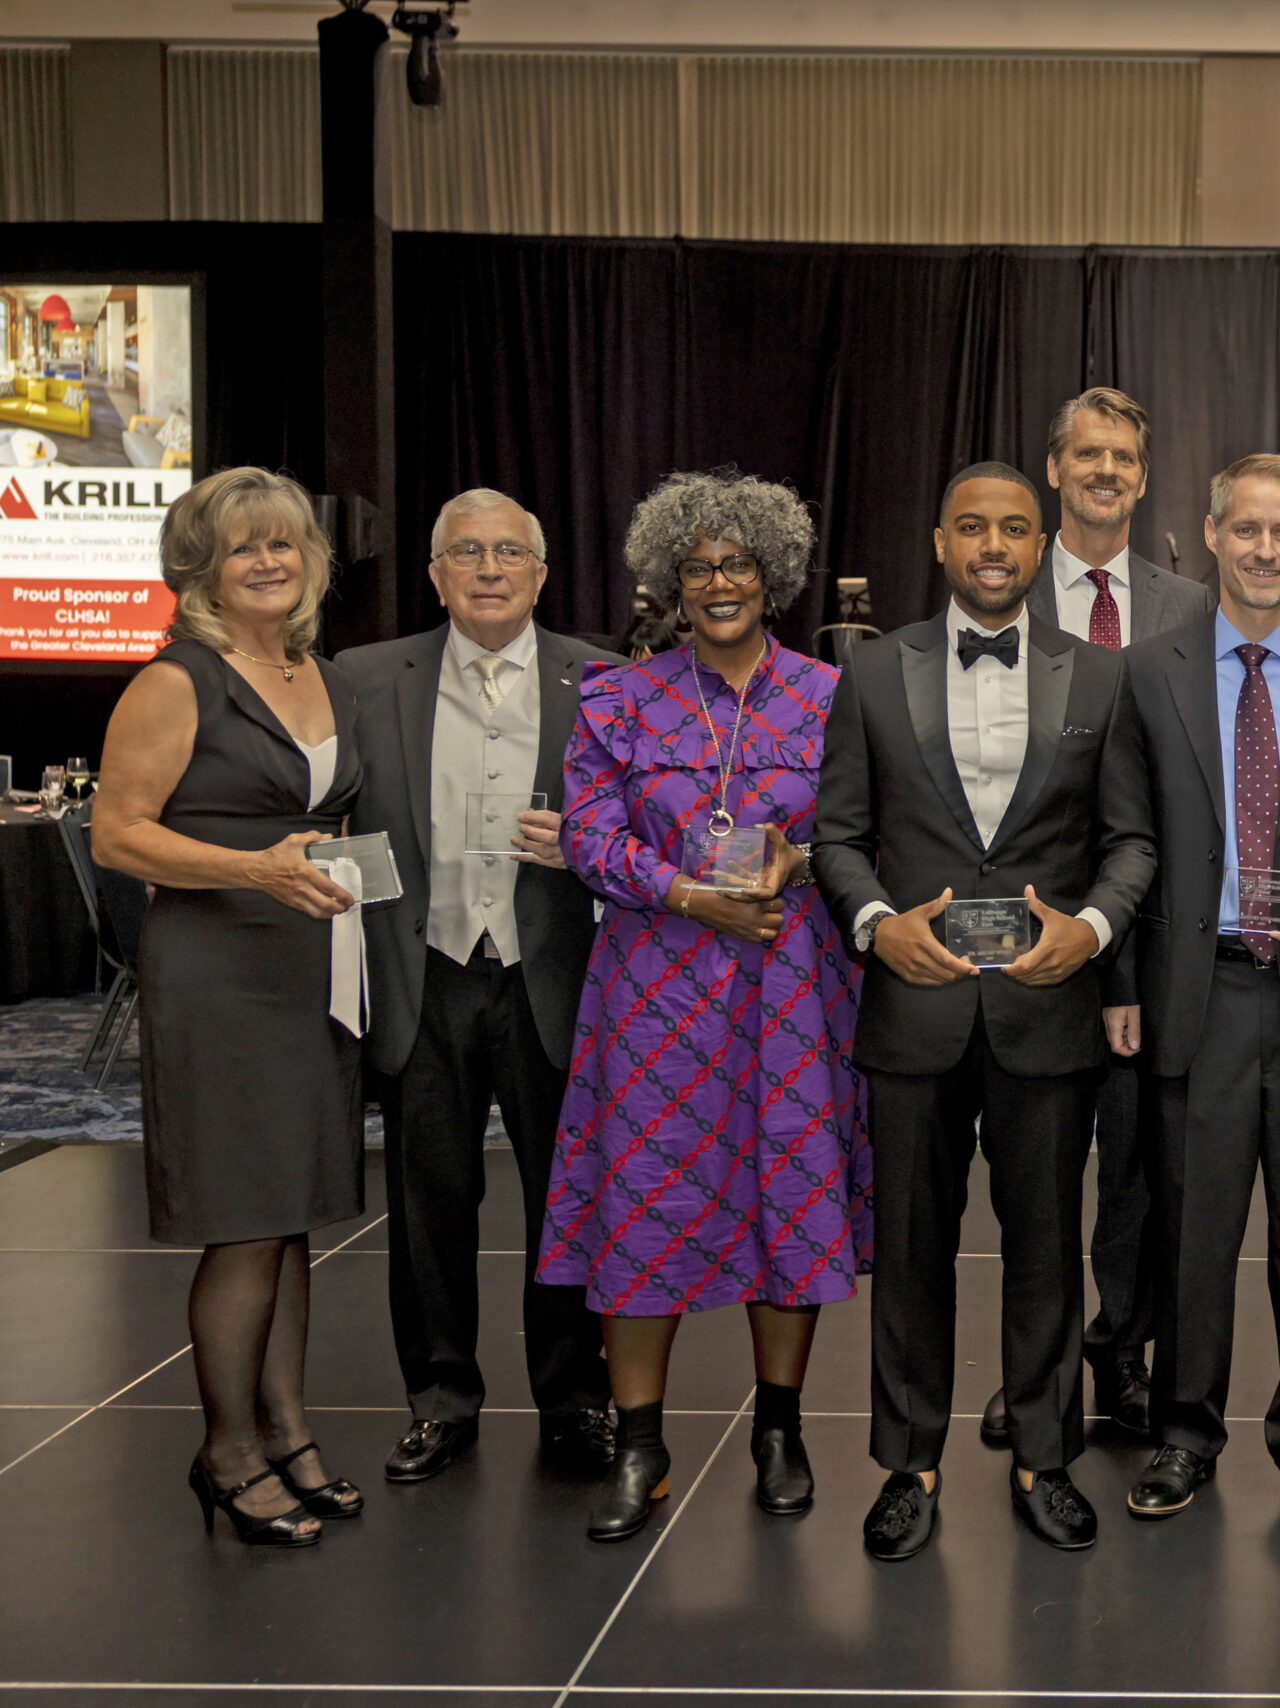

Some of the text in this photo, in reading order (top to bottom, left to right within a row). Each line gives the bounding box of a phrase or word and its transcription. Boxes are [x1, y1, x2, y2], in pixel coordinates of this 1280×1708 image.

[43, 480, 169, 508] KRILL
[44, 512, 59, 521] THE
[63, 512, 105, 522] BUILDING
[17, 535, 42, 545] Main
[127, 536, 145, 547] OH
[13, 586, 149, 606] Proud Sponsor of
[0, 626, 25, 637] hank
[28, 629, 47, 640] you
[49, 627, 63, 638] for
[66, 628, 79, 638] all
[81, 630, 100, 640] you
[102, 629, 117, 639] do
[119, 629, 131, 640] to
[11, 640, 28, 651] the
[30, 640, 70, 652] Greater
[72, 641, 126, 653] Cleveland
